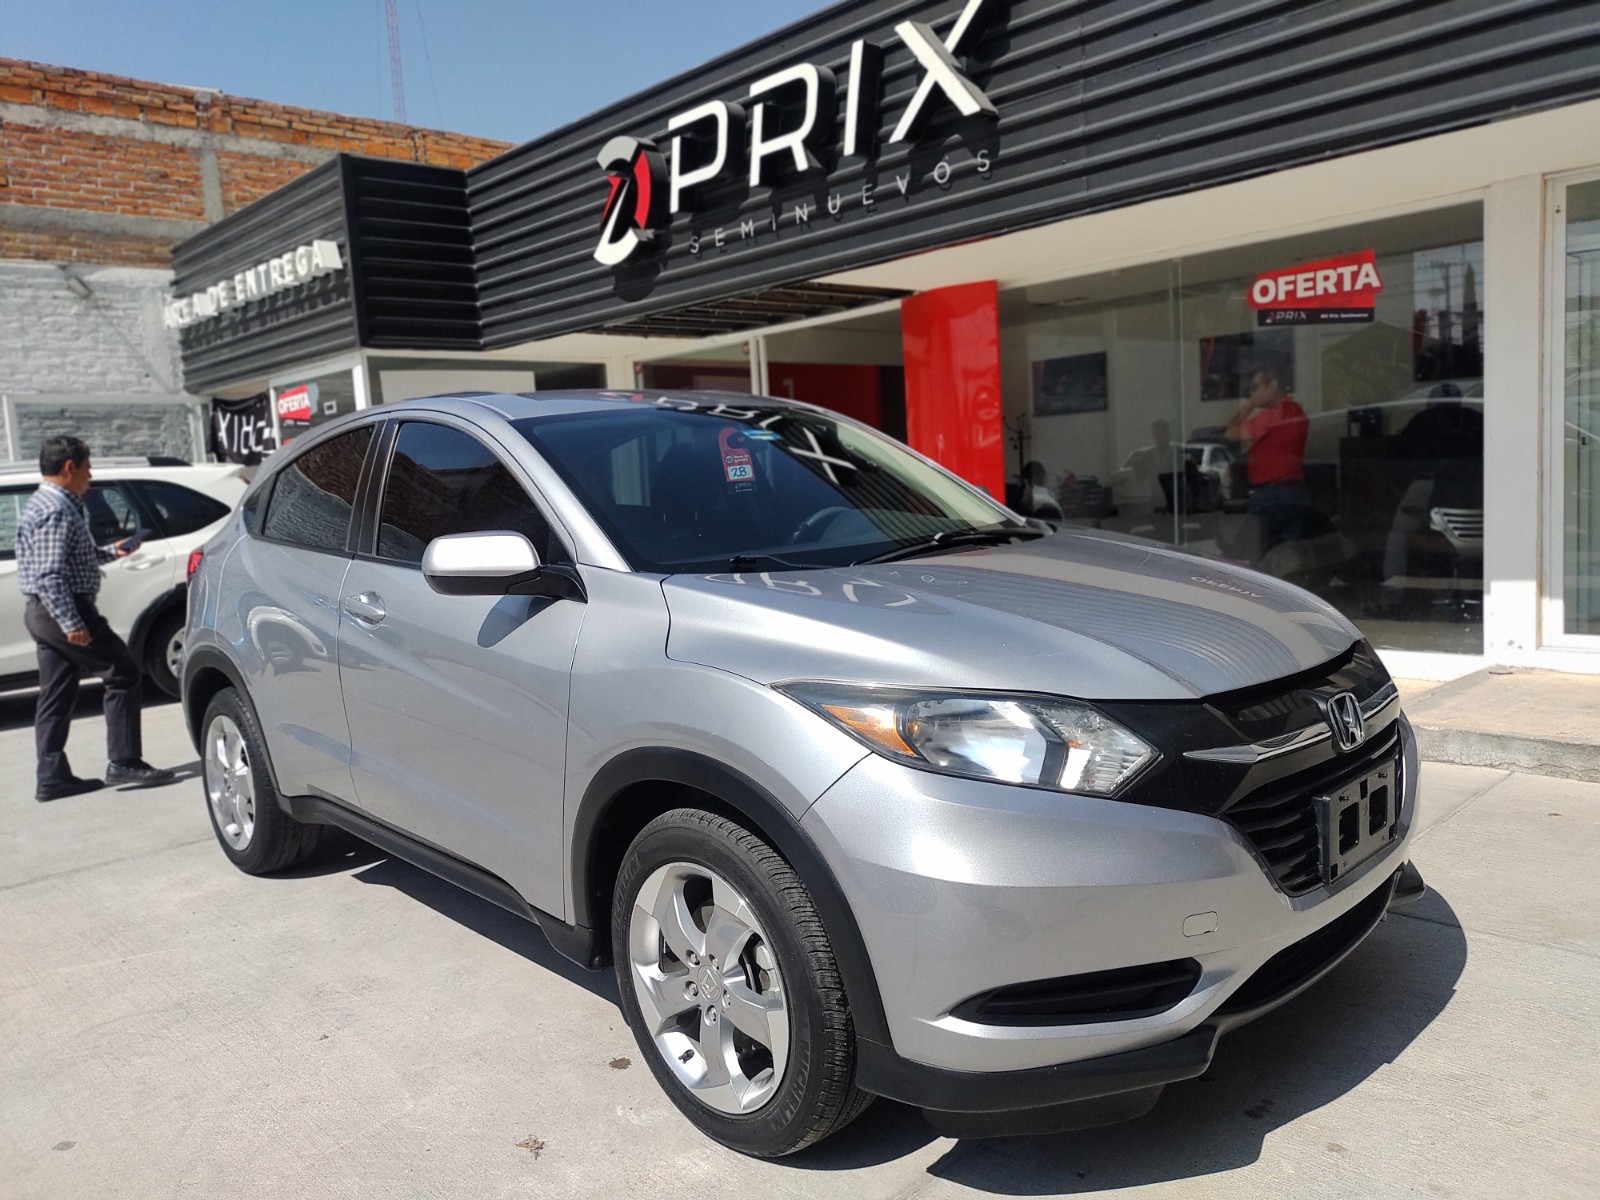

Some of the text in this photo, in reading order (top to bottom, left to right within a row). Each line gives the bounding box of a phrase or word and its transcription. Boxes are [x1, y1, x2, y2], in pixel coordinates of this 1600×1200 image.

[667, 0, 985, 214] PRIX
[689, 149, 991, 254] SEMINUEVOS
[234, 239, 342, 301] ENTREGA
[1252, 261, 1382, 304] OFERTA
[730, 466, 748, 478] 28
